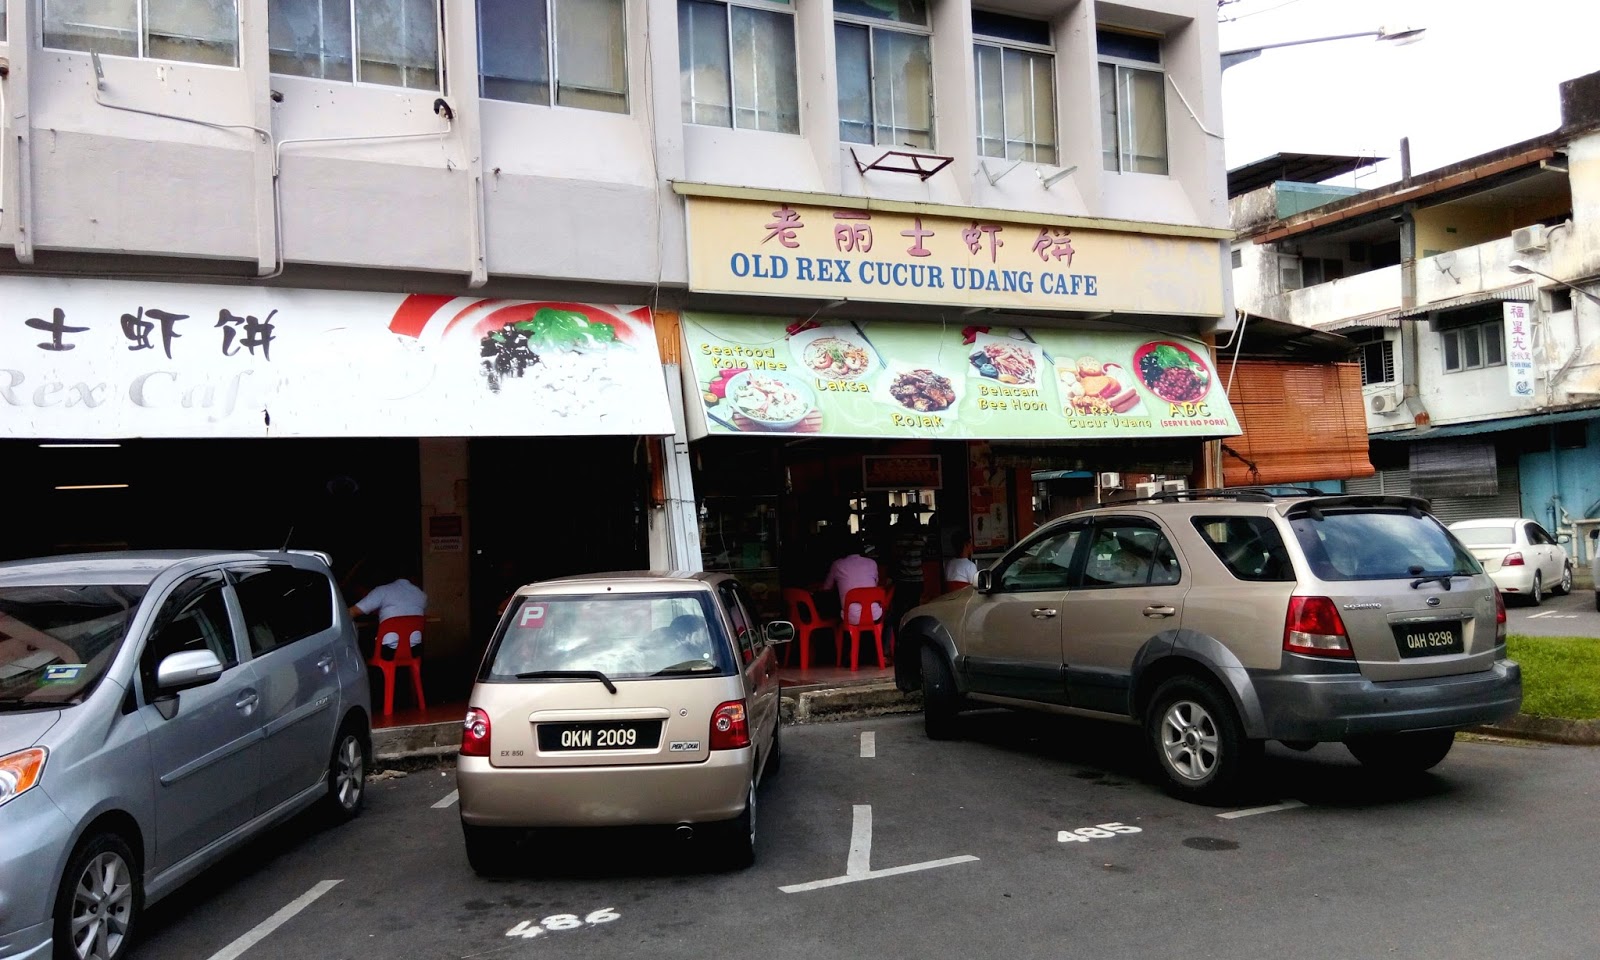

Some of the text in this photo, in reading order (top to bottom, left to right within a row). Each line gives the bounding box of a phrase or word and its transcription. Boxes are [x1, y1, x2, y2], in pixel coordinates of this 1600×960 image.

[760, 203, 1075, 268] 老丽士虾饼
[730, 252, 1098, 296] OLD REX CUCUR UDANG CAFE
[25, 305, 279, 361] 士虾饼
[700, 343, 775, 359] Seafood
[711, 357, 788, 371] Kolo Mee
[0, 369, 107, 408] Rex
[815, 379, 870, 393] Laksa
[977, 384, 1039, 398] Belacan
[977, 398, 1048, 412] Bee Hoon
[1063, 405, 1117, 417] Old Rex
[1169, 401, 1212, 418] ABC
[1068, 417, 1152, 429] Cucur Udang
[1160, 417, 1229, 428] (SERVE NO PORK)
[520, 606, 544, 627] P
[1407, 631, 1453, 649] QAH 9298
[561, 729, 637, 747] QKW 2009
[1057, 822, 1143, 843] 485
[505, 907, 621, 939] 486
